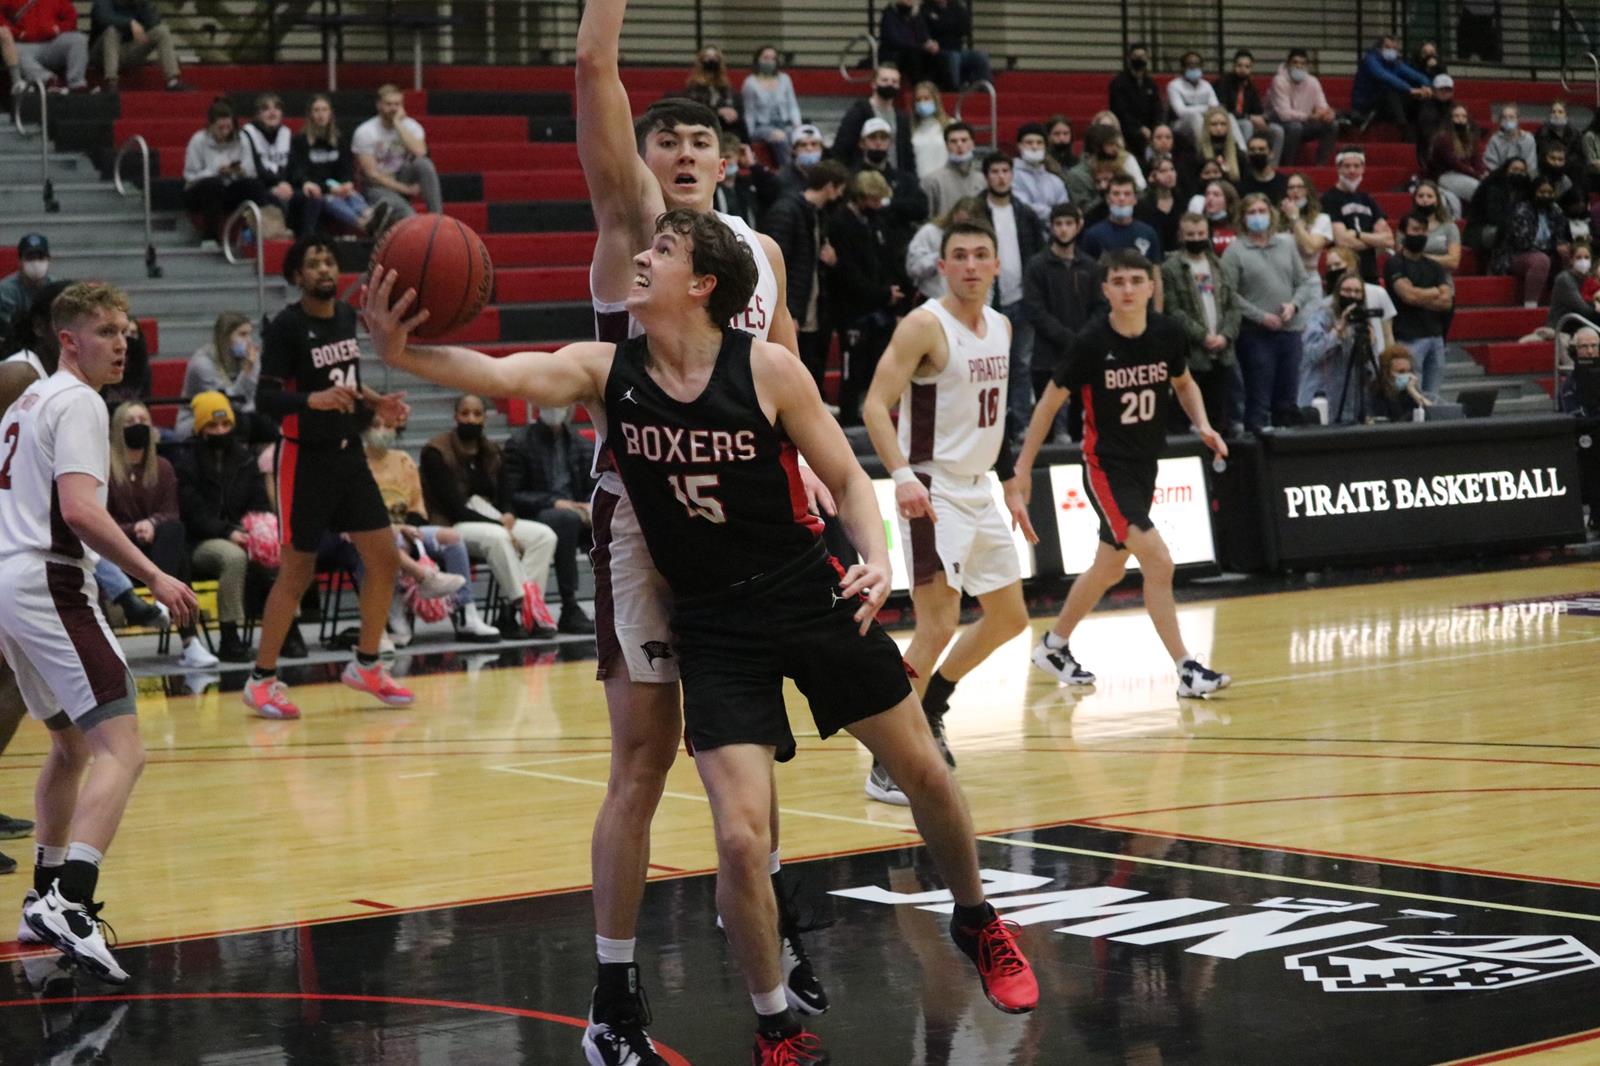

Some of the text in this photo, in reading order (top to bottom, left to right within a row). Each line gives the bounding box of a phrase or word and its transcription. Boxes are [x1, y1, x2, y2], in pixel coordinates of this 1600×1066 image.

[968, 355, 1009, 383] PIRATES
[1104, 361, 1168, 389] BOXERS
[1120, 389, 1156, 425] 20
[621, 422, 757, 462] BOXERS
[667, 474, 727, 524] 15
[1153, 484, 1193, 505] arm
[1284, 467, 1566, 518] PIRATE BASKETBALL
